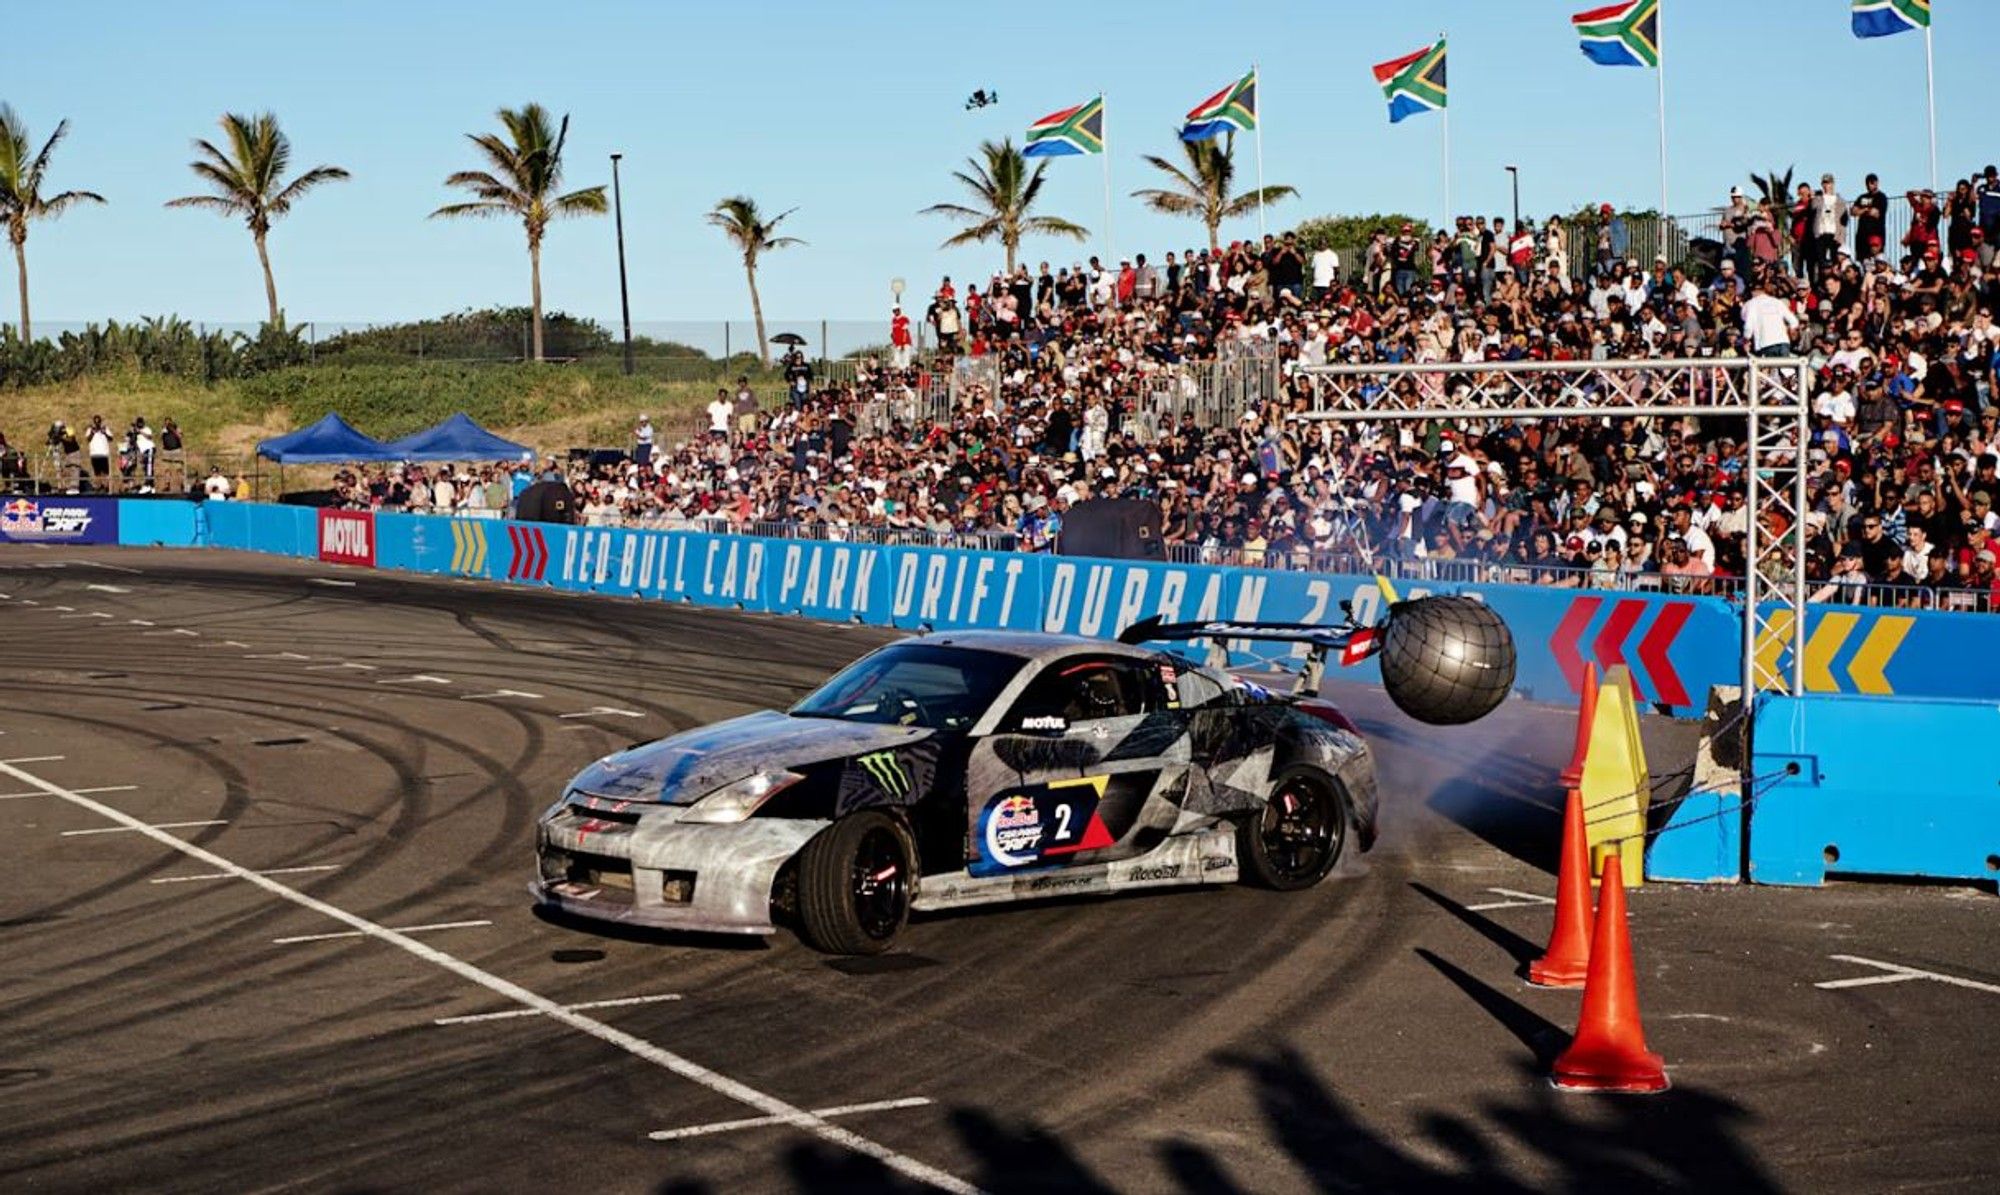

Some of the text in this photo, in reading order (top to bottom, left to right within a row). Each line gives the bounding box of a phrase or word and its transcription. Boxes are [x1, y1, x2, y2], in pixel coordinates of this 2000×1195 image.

[322, 517, 369, 557] MOTUL
[562, 530, 611, 584] RED
[619, 533, 687, 592] BULL
[703, 539, 764, 601] CAR
[779, 544, 878, 613] PARK
[892, 552, 1024, 628] DRIFT
[1044, 563, 1268, 652] DURBAN
[1021, 716, 1066, 730] MOTUL
[1055, 804, 1072, 841] 2
